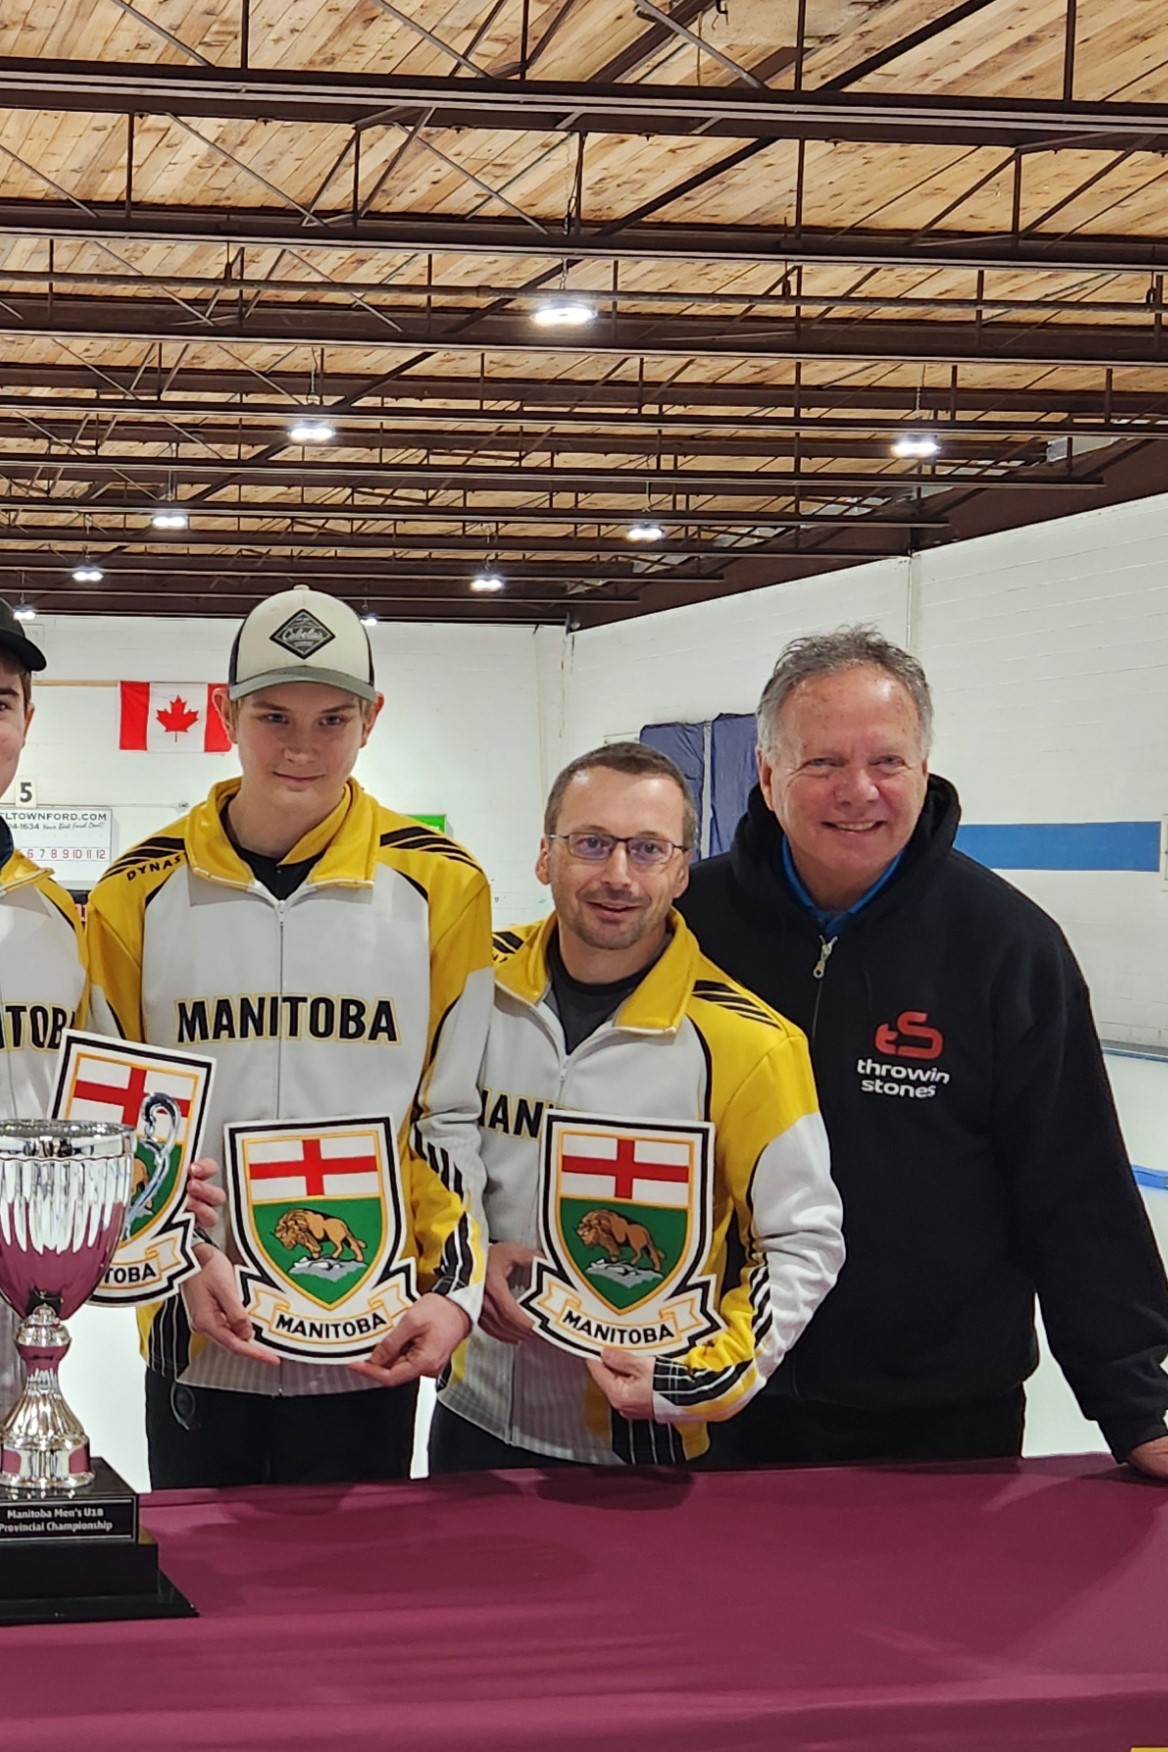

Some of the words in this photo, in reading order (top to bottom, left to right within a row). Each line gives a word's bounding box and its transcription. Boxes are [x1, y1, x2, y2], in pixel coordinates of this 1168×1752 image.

[19, 782, 33, 803] 5
[27, 849, 34, 858] 6
[39, 849, 45, 858] 7
[51, 849, 58, 858] 8
[63, 849, 70, 858] 9
[73, 849, 83, 859] 10
[87, 849, 92, 859] 11
[97, 849, 106, 859] 12
[176, 995, 398, 1043] MANITOBA
[857, 1058, 950, 1085] throwin
[861, 1079, 937, 1098] stones
[275, 1312, 388, 1339] MANITOBA
[562, 1309, 675, 1345] MANITOBA
[7, 1509, 52, 1519] Manitoba
[54, 1508, 82, 1518] Men's
[84, 1507, 104, 1517] U18
[47, 1519, 113, 1533] Championship
